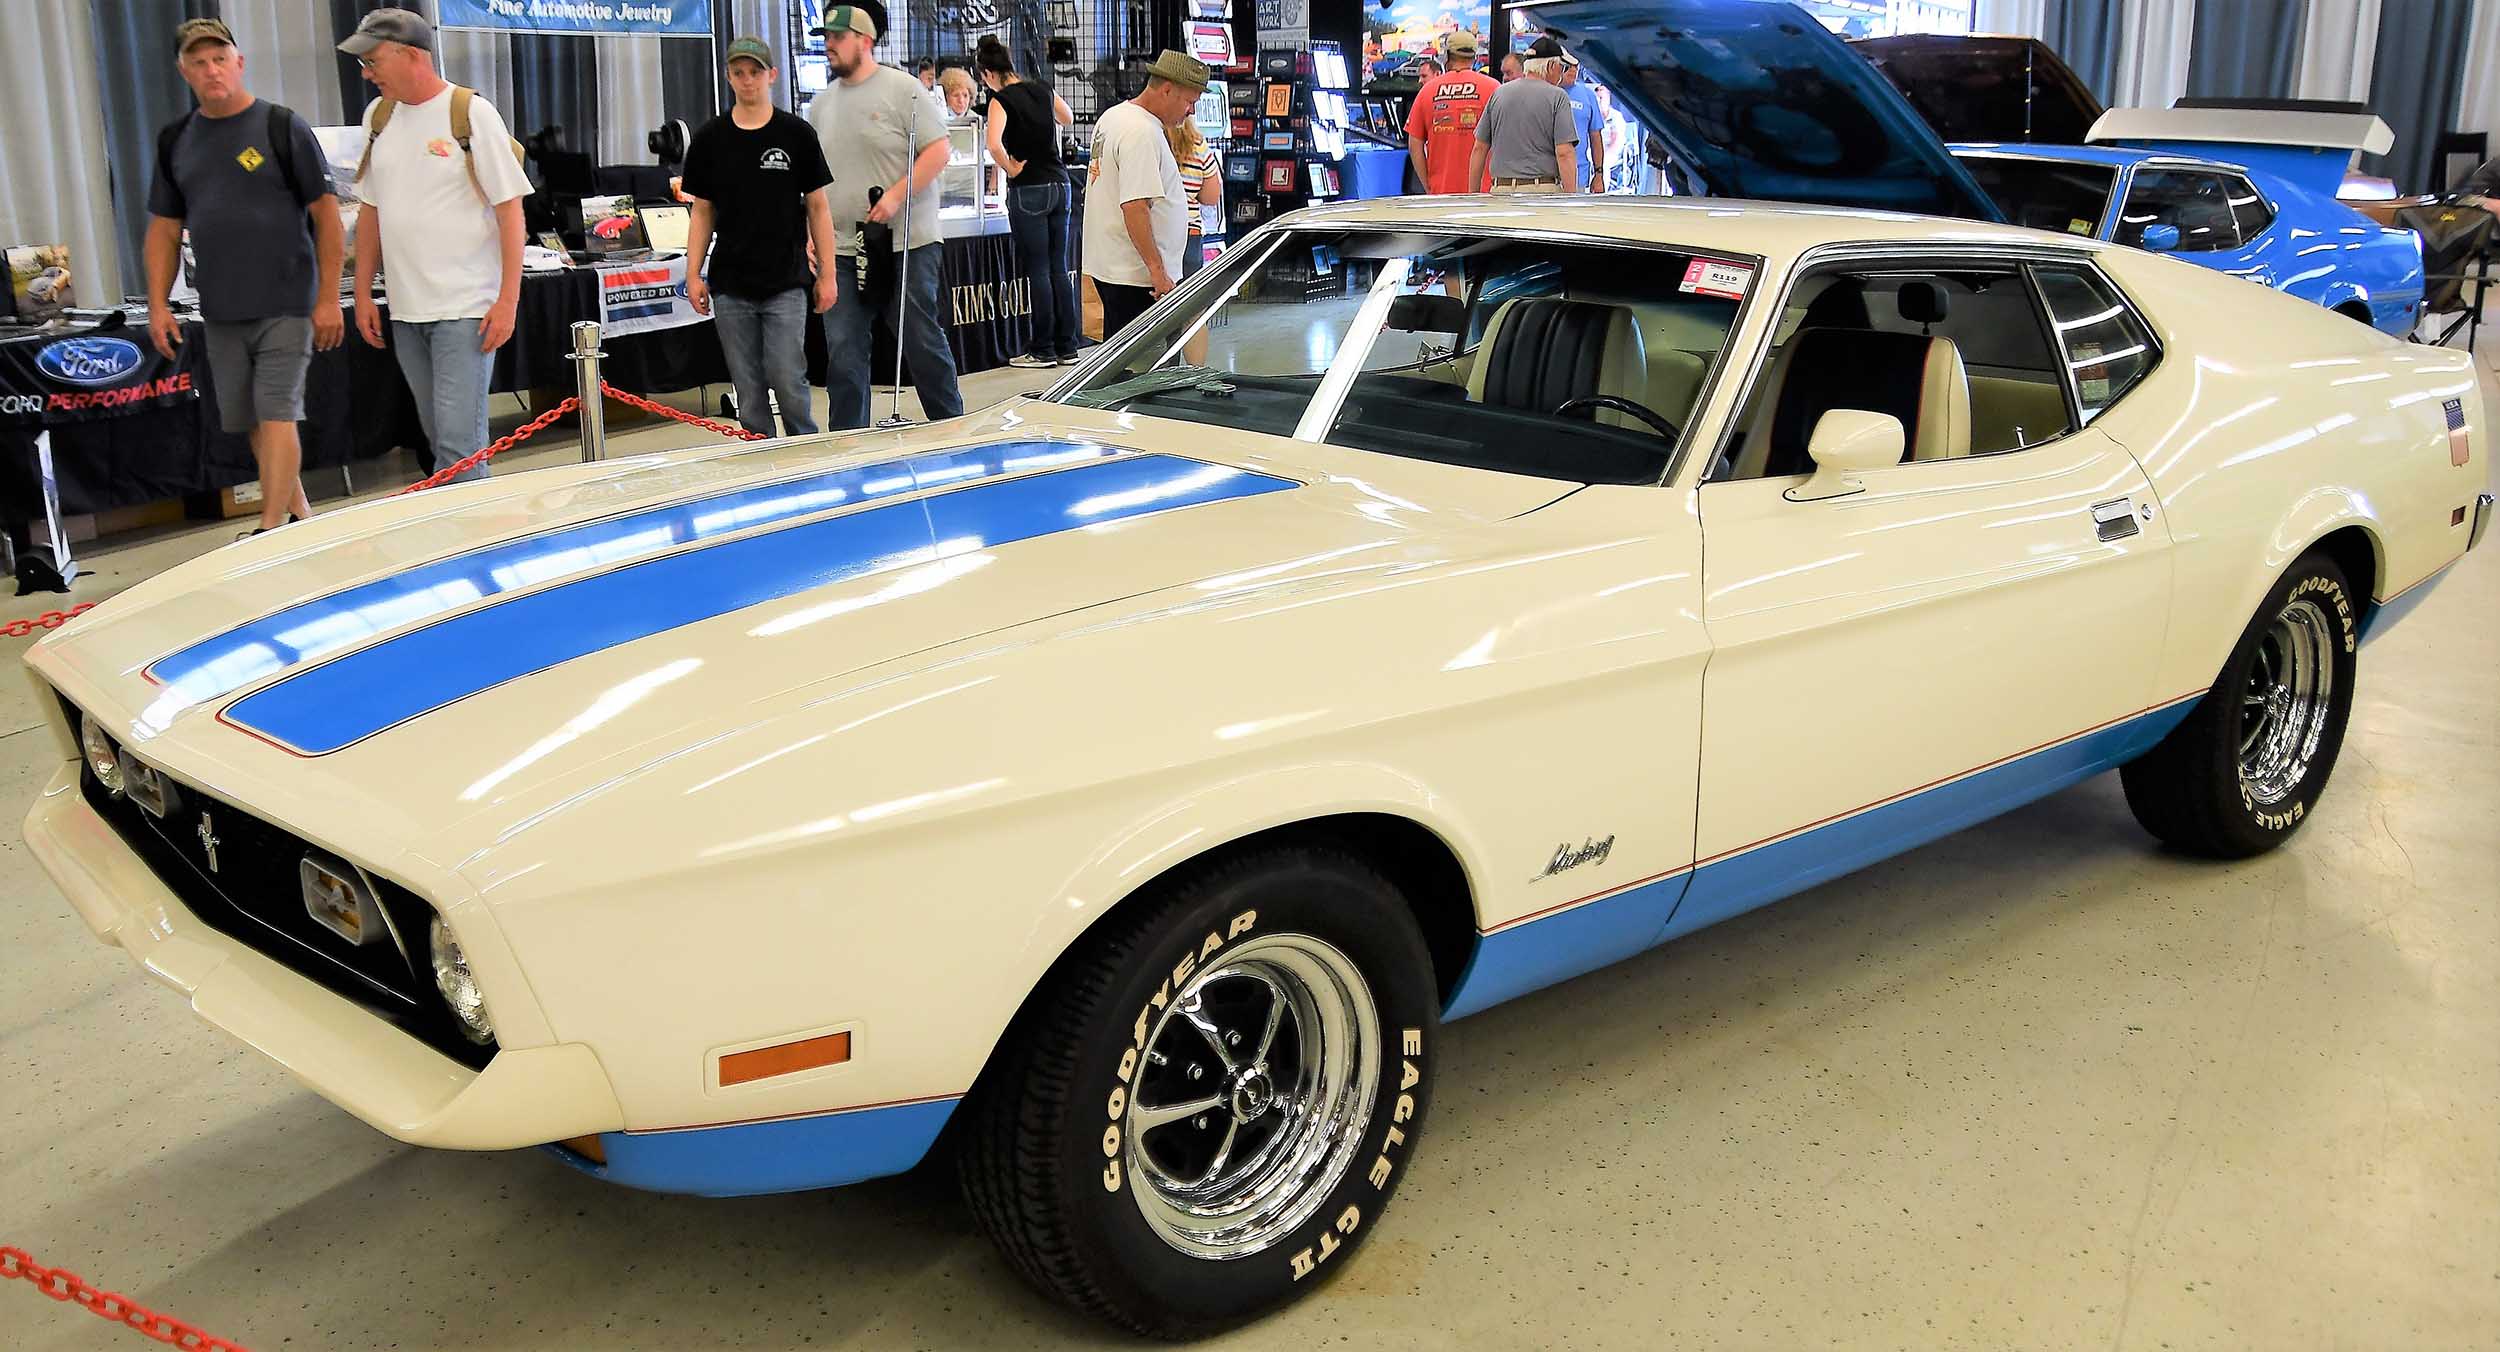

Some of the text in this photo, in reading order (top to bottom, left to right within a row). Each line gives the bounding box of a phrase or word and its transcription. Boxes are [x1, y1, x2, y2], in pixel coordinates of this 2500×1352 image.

[486, 0, 672, 25] Fine Automotive Jewelry
[1258, 0, 1280, 14] ART
[1258, 14, 1281, 28] WORK
[1438, 83, 1476, 96] NPD
[1712, 273, 1738, 282] R119
[606, 289, 656, 304] POWERED
[658, 286, 673, 298] BY
[952, 282, 995, 326] KIM'S
[999, 277, 1032, 319] GOL
[60, 346, 123, 378] Ford
[0, 372, 193, 414] ORD PERFORMANCE
[2287, 576, 2355, 653] GOODYEAR
[2255, 801, 2304, 831] EAGLE
[1528, 834, 1616, 884] Mustang
[1103, 910, 1258, 1193] GOODYEAR
[1368, 1029, 1422, 1191] EAGLE
